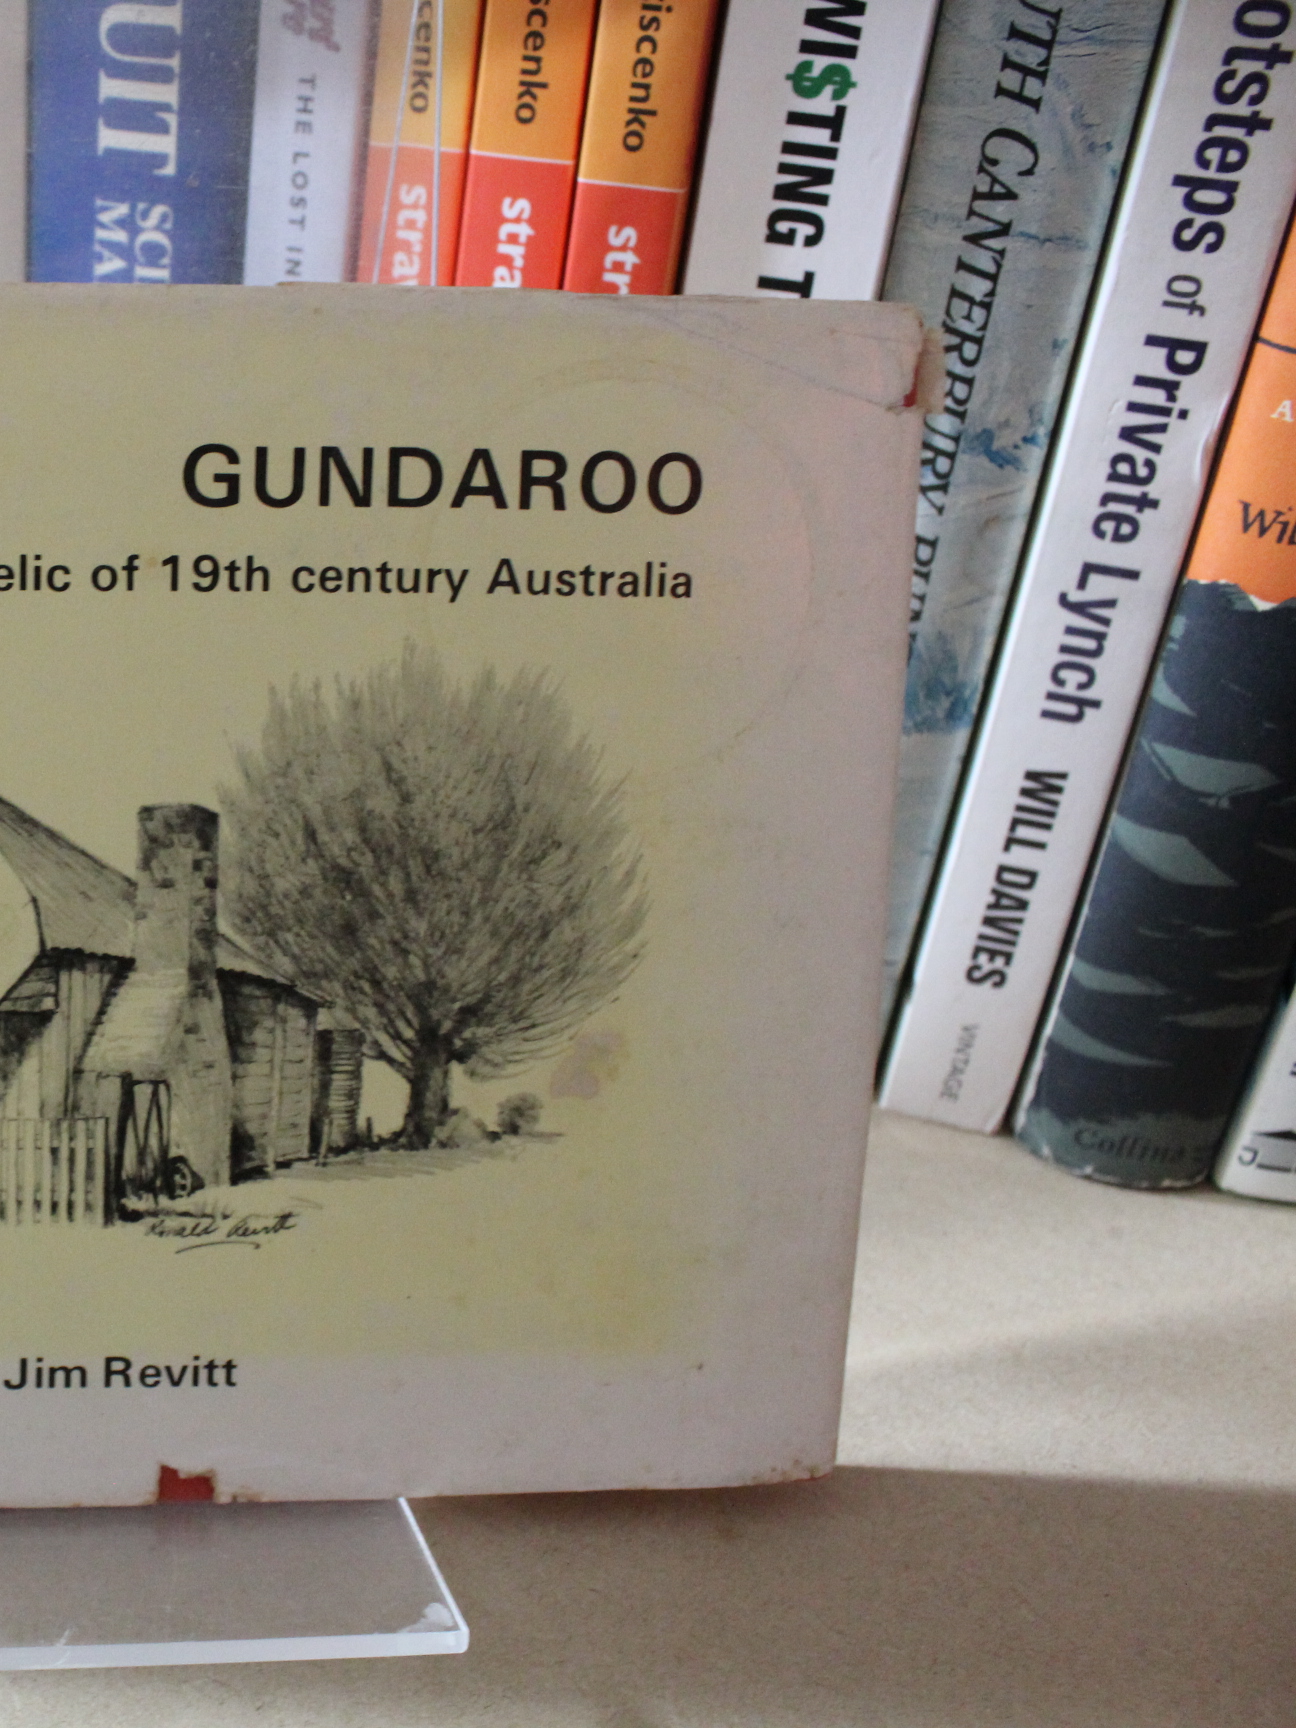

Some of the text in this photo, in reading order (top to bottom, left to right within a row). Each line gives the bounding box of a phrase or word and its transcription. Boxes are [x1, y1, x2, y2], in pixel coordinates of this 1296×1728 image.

[284, 74, 317, 278] THE LOST IN
[1164, 274, 1207, 318] of
[182, 443, 703, 515] GUNDAROO
[1093, 334, 1210, 544] Private
[91, 554, 140, 592] of
[161, 554, 270, 593] 19th
[291, 561, 469, 604] century
[486, 558, 692, 599] Australia
[1042, 561, 1142, 724] Lynch
[966, 770, 1070, 990] WILL DAVIES
[3, 1357, 87, 1390] Jim
[104, 1355, 237, 1388] Revitt
